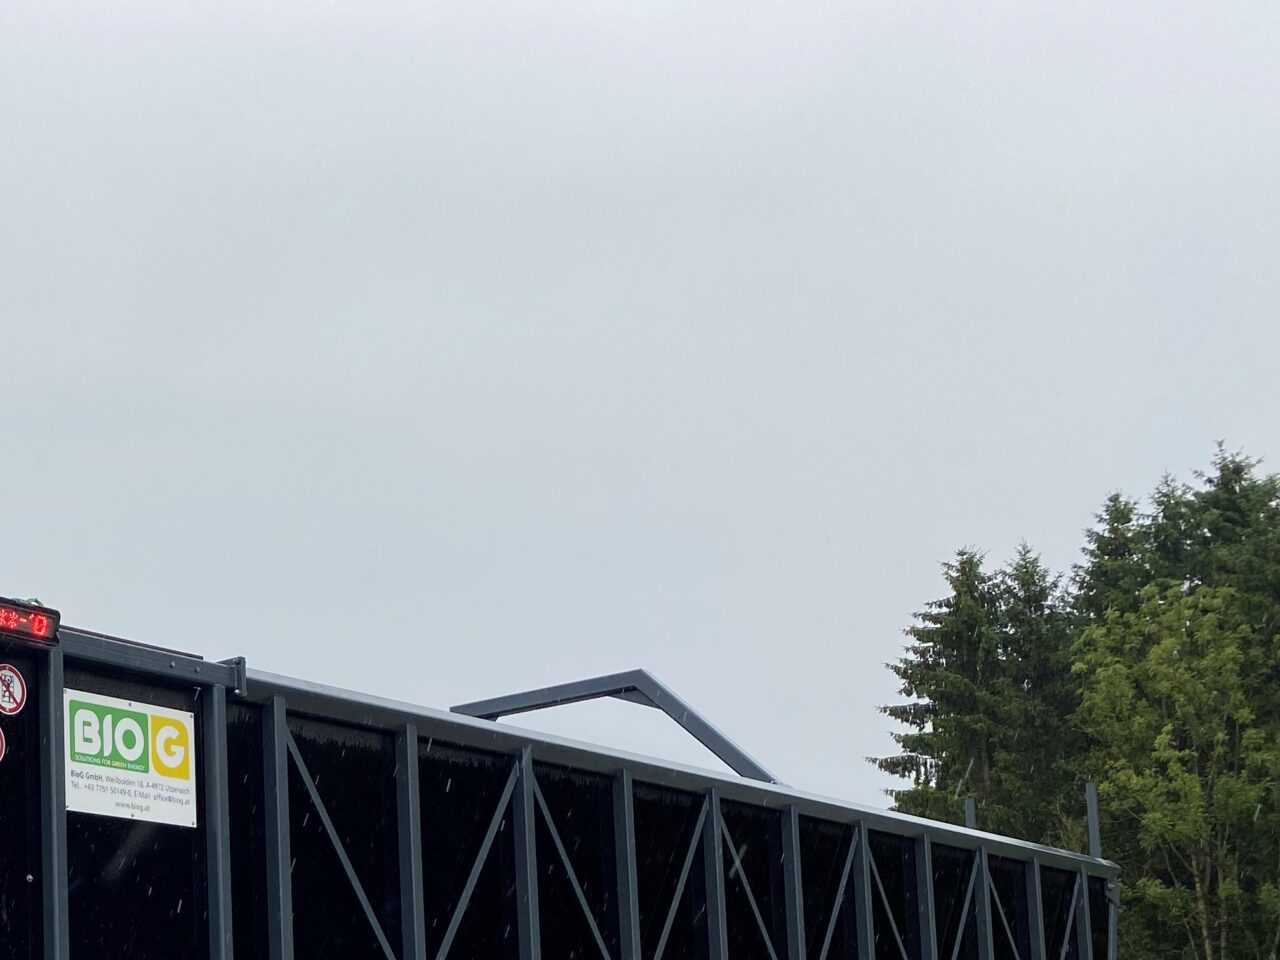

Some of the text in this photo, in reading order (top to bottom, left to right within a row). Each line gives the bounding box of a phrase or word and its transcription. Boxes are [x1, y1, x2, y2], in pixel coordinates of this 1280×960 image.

[111, 760, 127, 769] GREEN
[127, 762, 145, 771] ENERGY
[70, 769, 84, 779] BioG
[85, 772, 104, 782] GmbH,
[115, 801, 150, 812] www.biog.at
